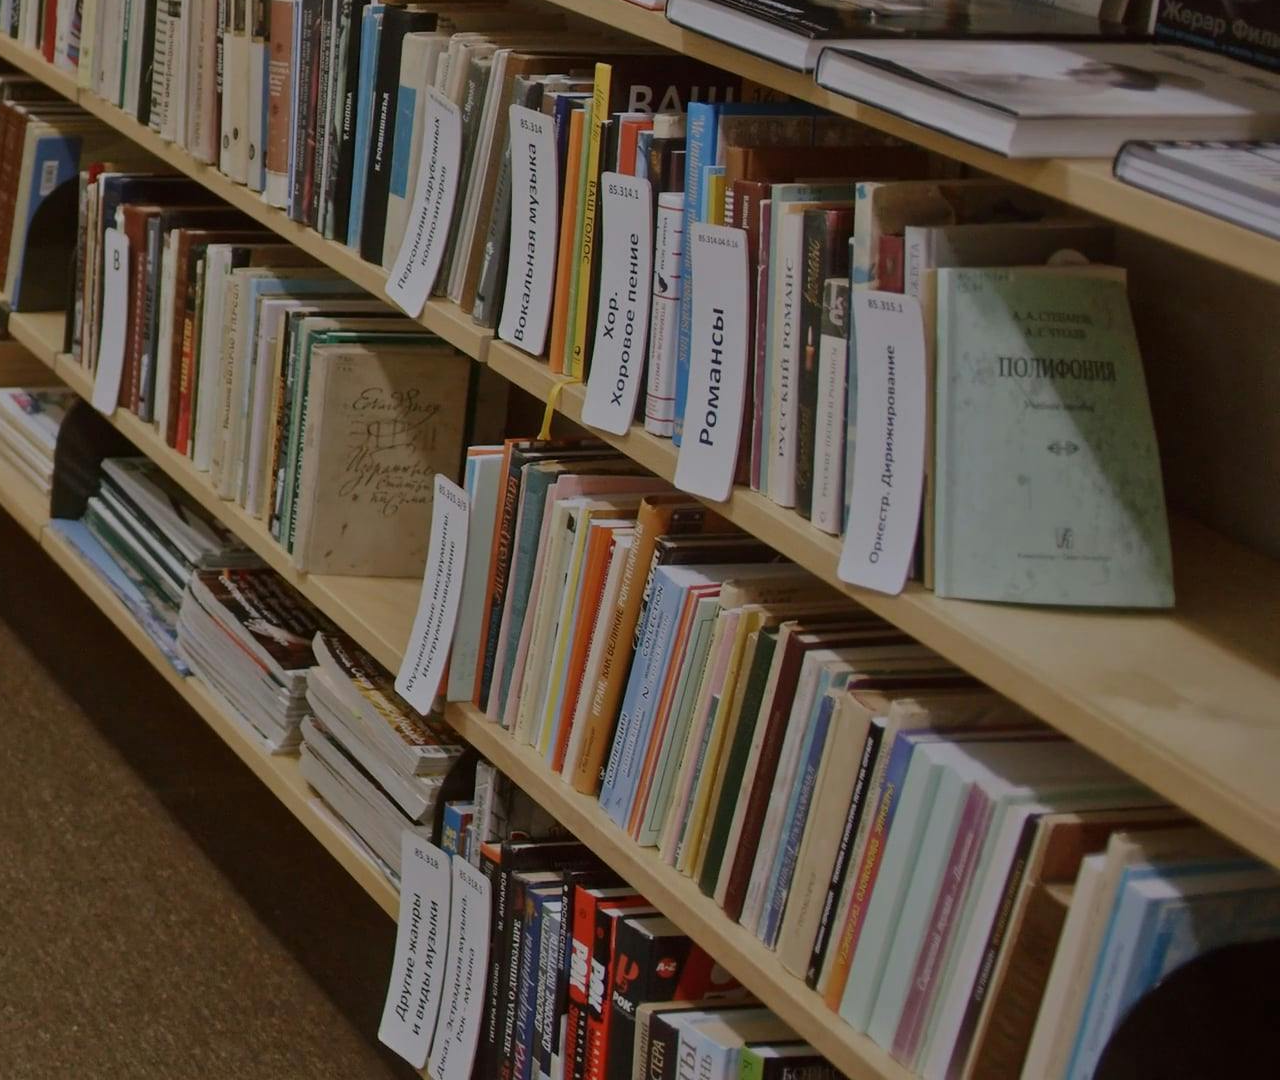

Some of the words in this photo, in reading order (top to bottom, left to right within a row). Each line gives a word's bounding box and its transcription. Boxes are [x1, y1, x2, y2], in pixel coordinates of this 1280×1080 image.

[1161, 0, 1227, 35] Жерар
[344, 91, 353, 132] ПОПОВА
[519, 118, 543, 136] 85.314
[395, 206, 430, 291] Персоналии
[423, 116, 442, 205] зарубежных
[525, 142, 538, 226] музыка
[419, 165, 449, 267] композиторов
[582, 216, 595, 265] ГОЛОС
[513, 228, 538, 343] Вокальная
[601, 291, 619, 341] Хор.
[781, 256, 795, 349] РОМАНС
[866, 298, 905, 314] 85.315.1
[610, 309, 635, 407] Хоровое
[628, 233, 640, 303] пение
[698, 307, 726, 448] Романсы
[997, 356, 1117, 382] ПОЛИФОНИЯ
[776, 356, 793, 459] РУССКИЙ
[867, 491, 891, 565] Оркестр.
[881, 344, 899, 488] Дирижирование
[617, 522, 644, 608] РОК-ГИТАРИСТЫ
[405, 603, 437, 693] Музыкальные
[431, 512, 450, 600] инструменты.
[421, 541, 456, 678] Инструментоведение
[603, 607, 624, 657] ВЕЛИКИЕ
[642, 584, 664, 658] COLLECTION
[600, 658, 613, 679] КАК
[604, 712, 629, 788] КОЛЛЕКЦИЯ
[414, 848, 440, 869] 85.318
[497, 919, 505, 931] М.
[498, 871, 507, 918] АНЧАРОВ
[395, 956, 416, 1023] Другие
[407, 892, 423, 955] жанры
[425, 899, 439, 970] музыки
[508, 918, 522, 991] ДИНОЗАВРЕ
[538, 912, 552, 970] ПОРТРЕТЫ
[546, 933, 559, 989] ПОРТРЕТЫ
[558, 896, 569, 970] ВОСКРЕСЕНИЕ
[446, 955, 464, 1032] Эстрадная
[455, 1016, 466, 1043] Рок
[463, 947, 476, 1005] музыка
[508, 991, 516, 1000] О
[569, 937, 589, 993] РОК
[589, 957, 606, 1014] РОК
[415, 971, 431, 1021] виды
[488, 1007, 498, 1044] ГИТАРА
[533, 971, 548, 1033] ДЖАЗОВЫЕ
[542, 993, 555, 1054] ДЖАЗОВЫЕ
[412, 1023, 422, 1036] и
[503, 1002, 516, 1057] ЛЕГЕНДА
